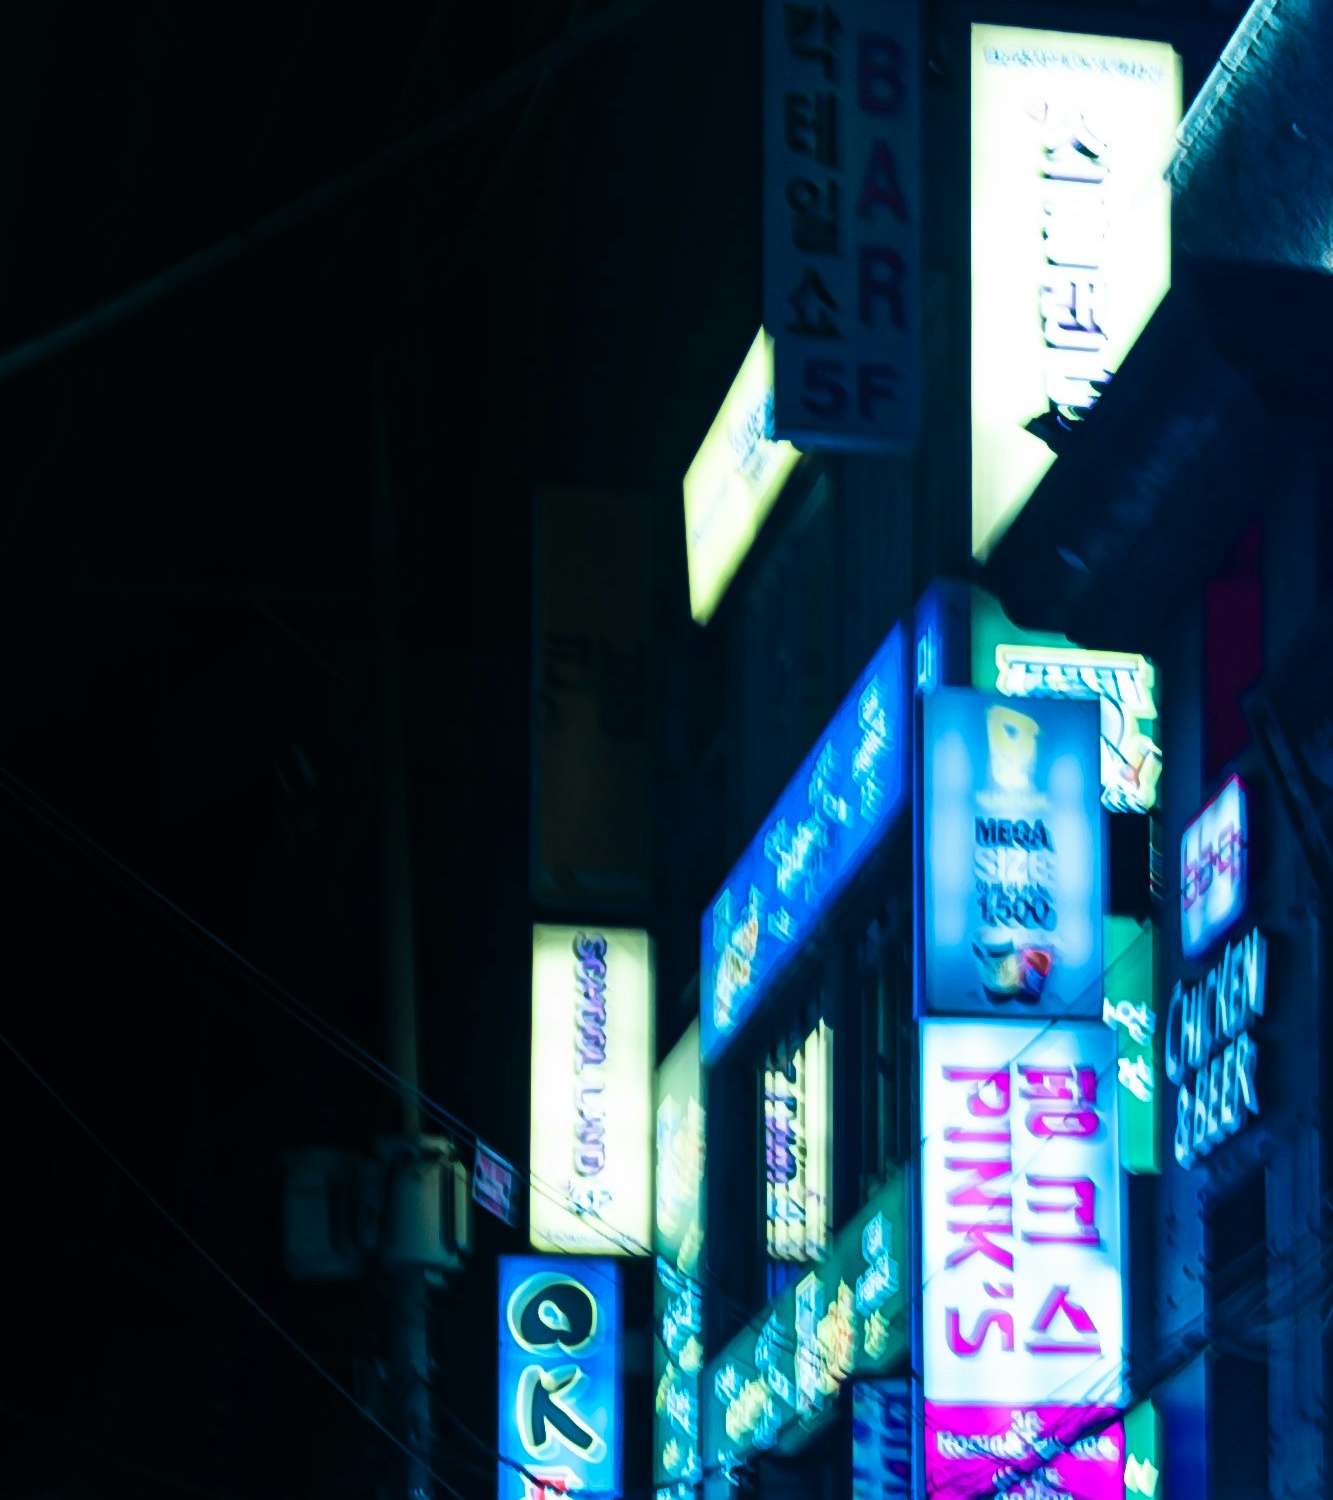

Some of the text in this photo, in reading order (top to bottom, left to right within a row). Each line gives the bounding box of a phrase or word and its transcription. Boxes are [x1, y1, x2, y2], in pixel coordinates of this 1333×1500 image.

[856, 34, 906, 329] BAR
[802, 360, 897, 420] 5F
[1165, 925, 1267, 1088] CHICKEN
[942, 1064, 1016, 1358] PINK'S
